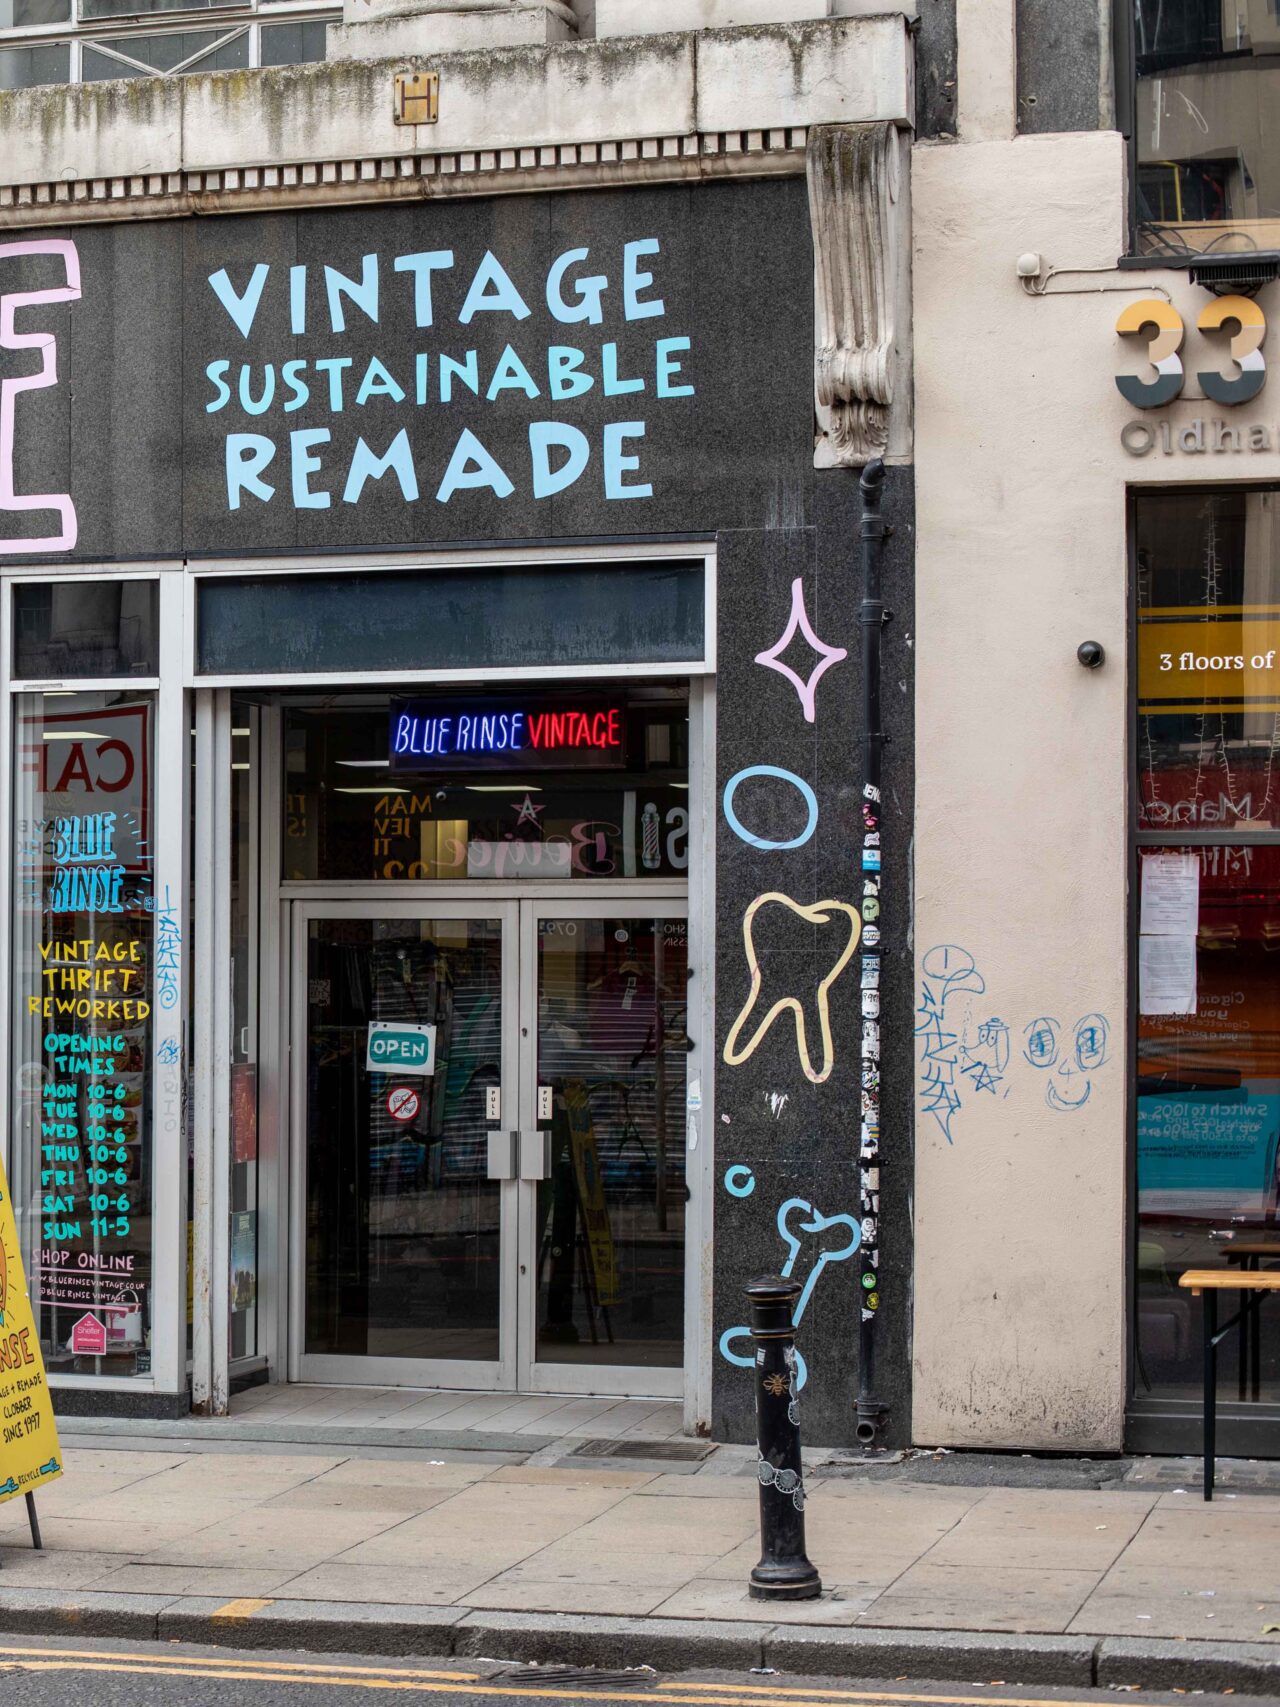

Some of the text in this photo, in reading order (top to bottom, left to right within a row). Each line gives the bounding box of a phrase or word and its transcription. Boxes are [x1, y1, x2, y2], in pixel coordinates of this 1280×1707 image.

[401, 78, 431, 119] H
[207, 238, 665, 339] VINTAGE
[1114, 294, 1267, 410] 33
[205, 336, 695, 416] SUSTAINABLE
[1120, 418, 1280, 457] Oldha
[226, 421, 654, 511] REMADE
[1159, 651, 1276, 672] 3 floors of
[394, 708, 621, 754] BLUE RINSE VINTAGE
[52, 811, 118, 864] BLUE
[51, 864, 126, 914] RINSE
[37, 939, 141, 962] VINTAGE
[42, 968, 137, 992] THRIFT
[27, 996, 151, 1020] REWORKED
[44, 1033, 126, 1053] OPENING
[373, 1039, 426, 1058] OPEN
[55, 1055, 115, 1075] TIMES
[43, 1083, 78, 1098] MON
[43, 1101, 78, 1119] TUE
[41, 1123, 79, 1139] WED
[41, 1145, 80, 1162] THU
[41, 1169, 75, 1186] FRI
[42, 1195, 75, 1213] SAT
[43, 1221, 82, 1240] SUN
[31, 1248, 135, 1271] SHOP ONLINE
[77, 1326, 101, 1335] Shelter
[16, 1371, 42, 1393] REMADE
[3, 1395, 33, 1419] CLOBBER
[2, 1411, 40, 1444] SINCE 1997
[17, 1468, 40, 1486] RECYCLE
